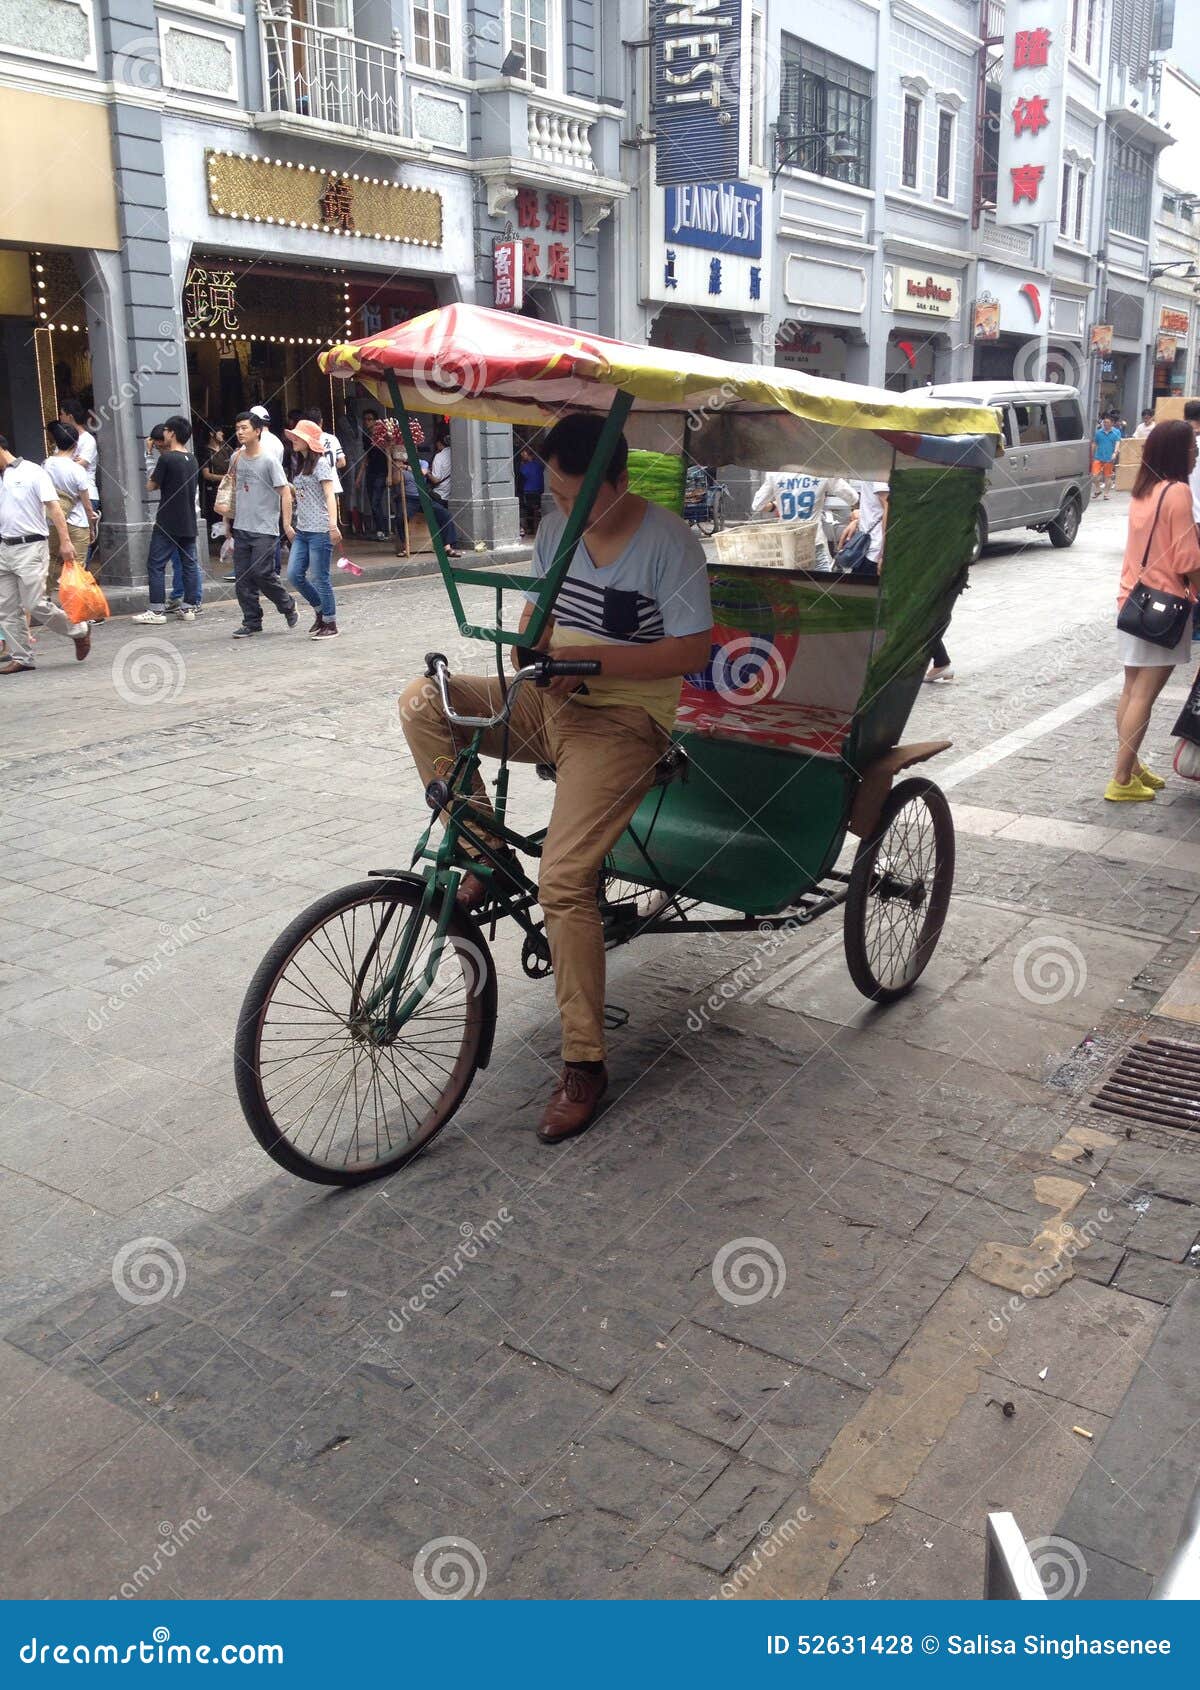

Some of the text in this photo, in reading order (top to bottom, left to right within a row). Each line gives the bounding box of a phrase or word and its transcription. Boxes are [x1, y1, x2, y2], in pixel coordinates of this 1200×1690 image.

[495, 246, 511, 305] 客房
[183, 267, 240, 331] 鏡
[787, 477, 811, 489] NYC
[781, 491, 815, 520] 09
